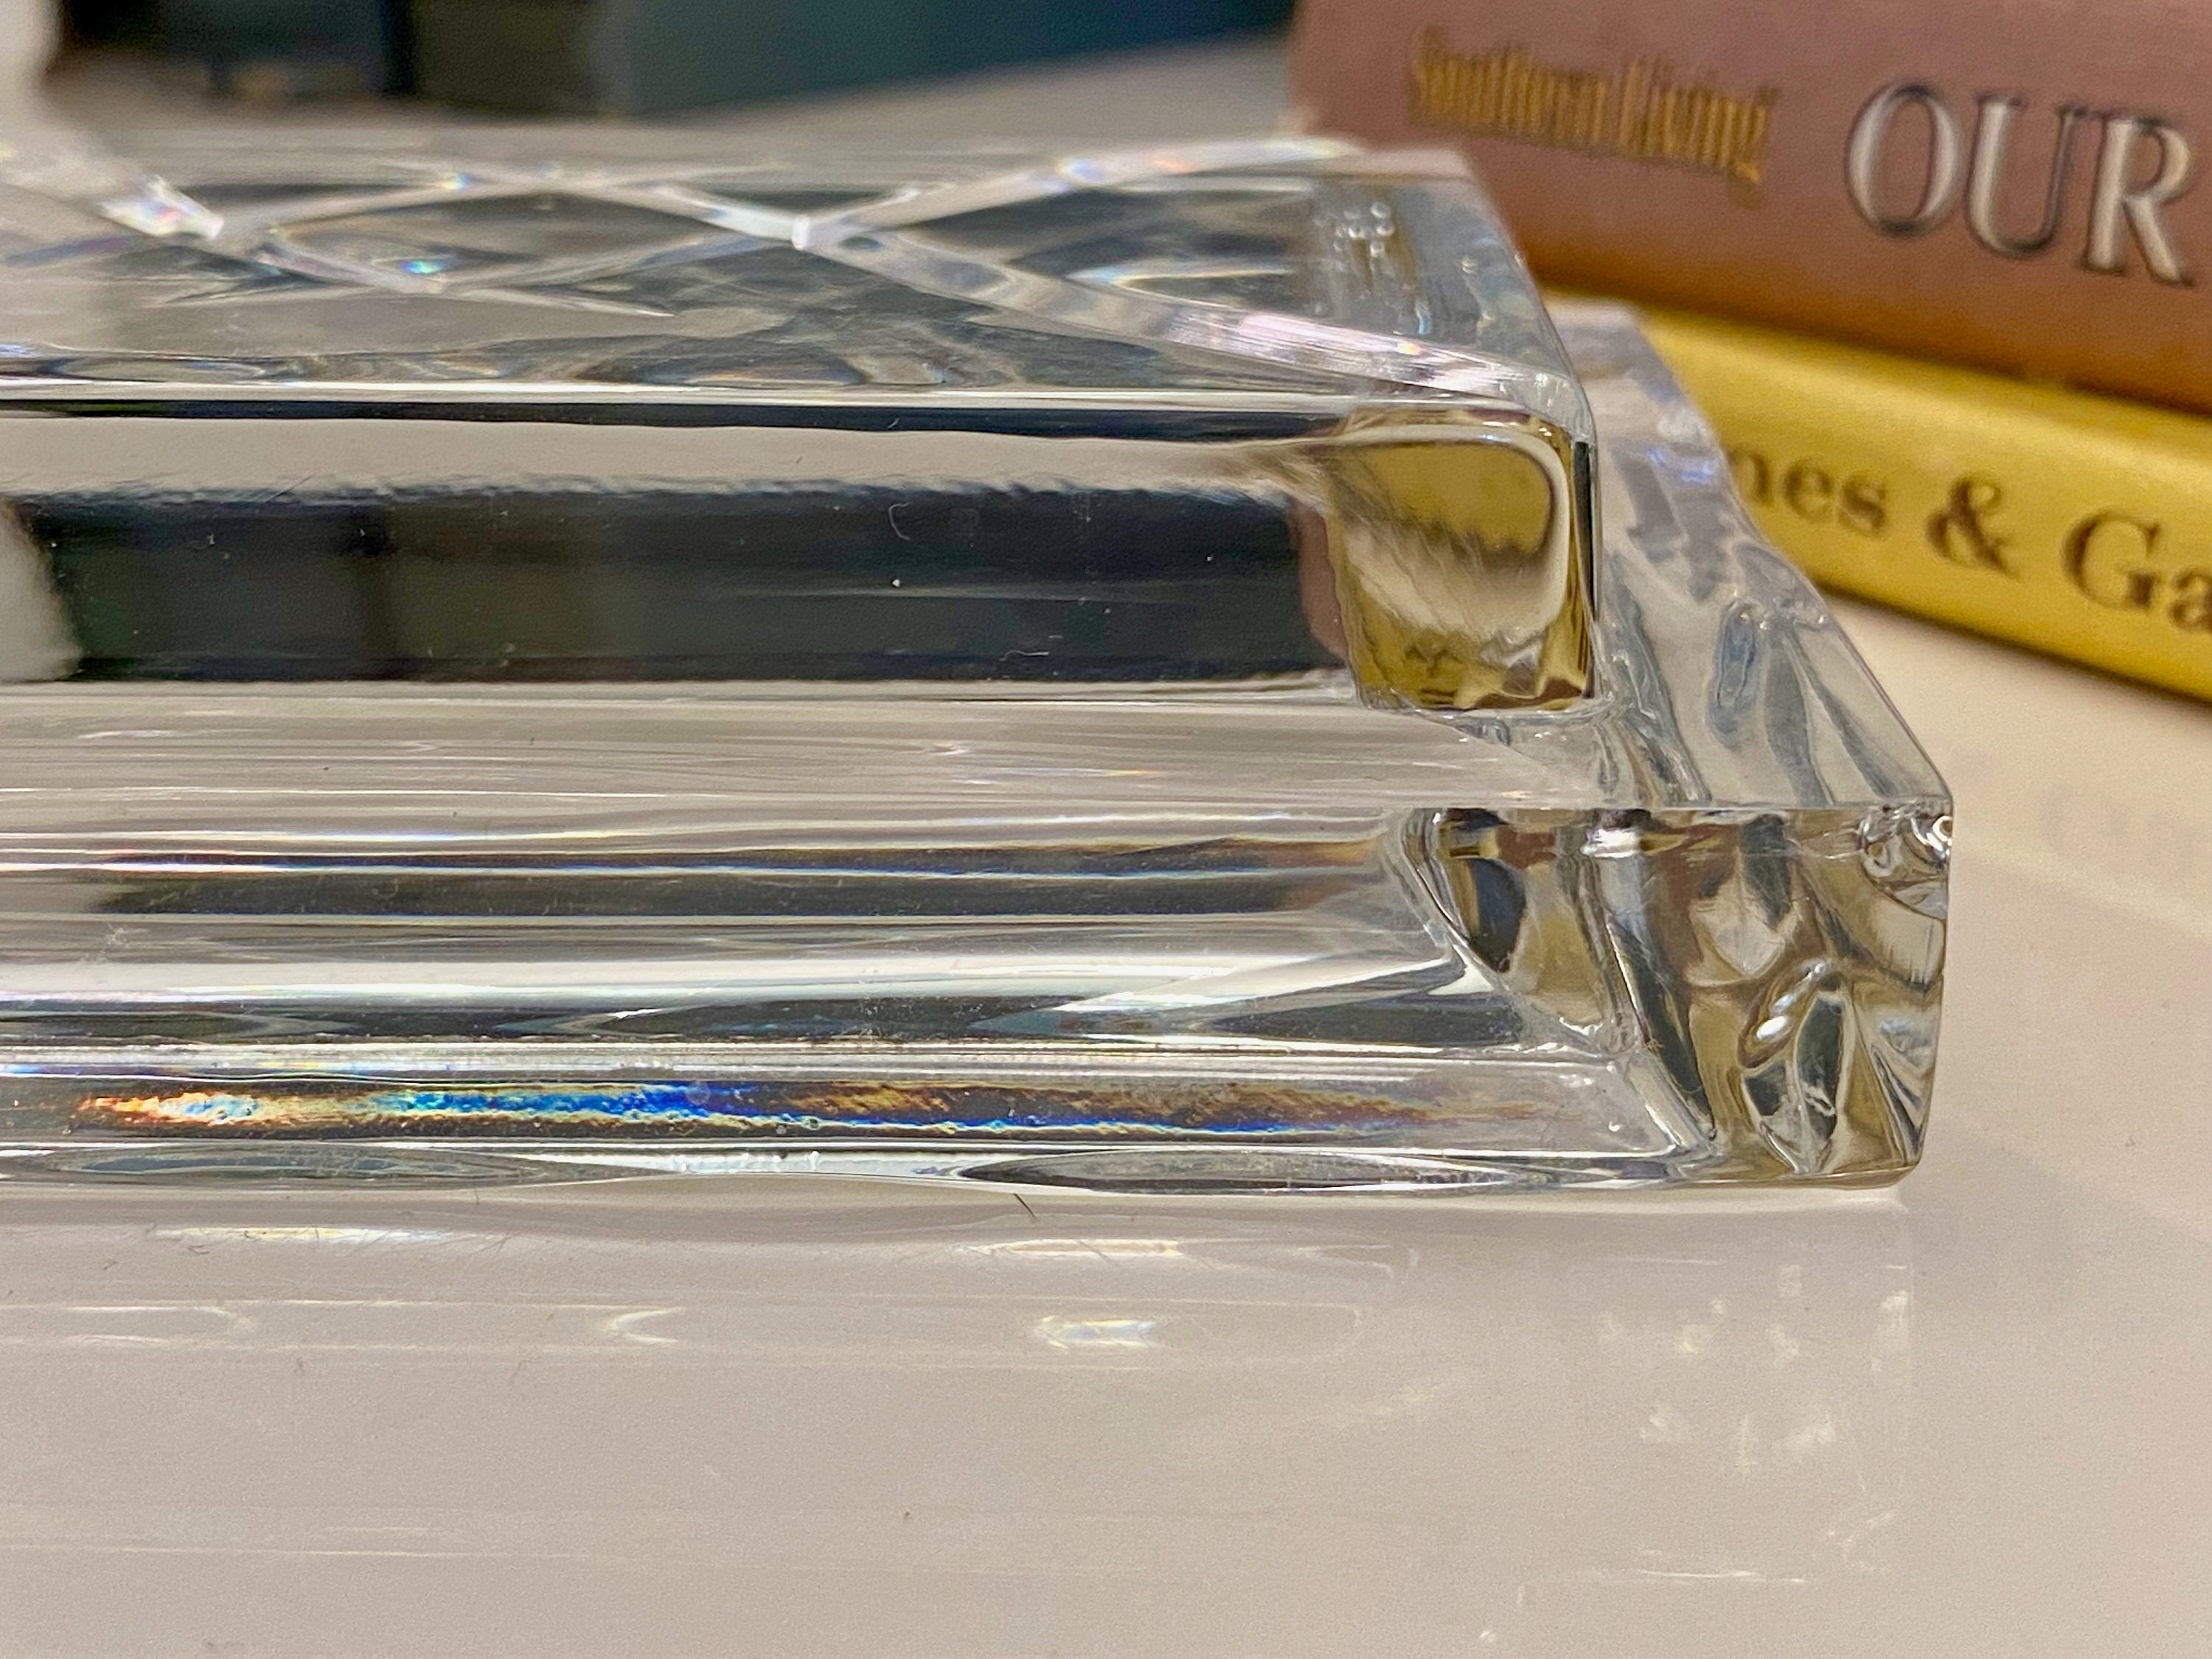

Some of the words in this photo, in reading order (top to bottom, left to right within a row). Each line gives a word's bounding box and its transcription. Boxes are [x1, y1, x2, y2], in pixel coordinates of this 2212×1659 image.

[1846, 81, 2196, 288] OUR
[1925, 472, 2017, 580] &
[2062, 507, 2212, 634] Ga
